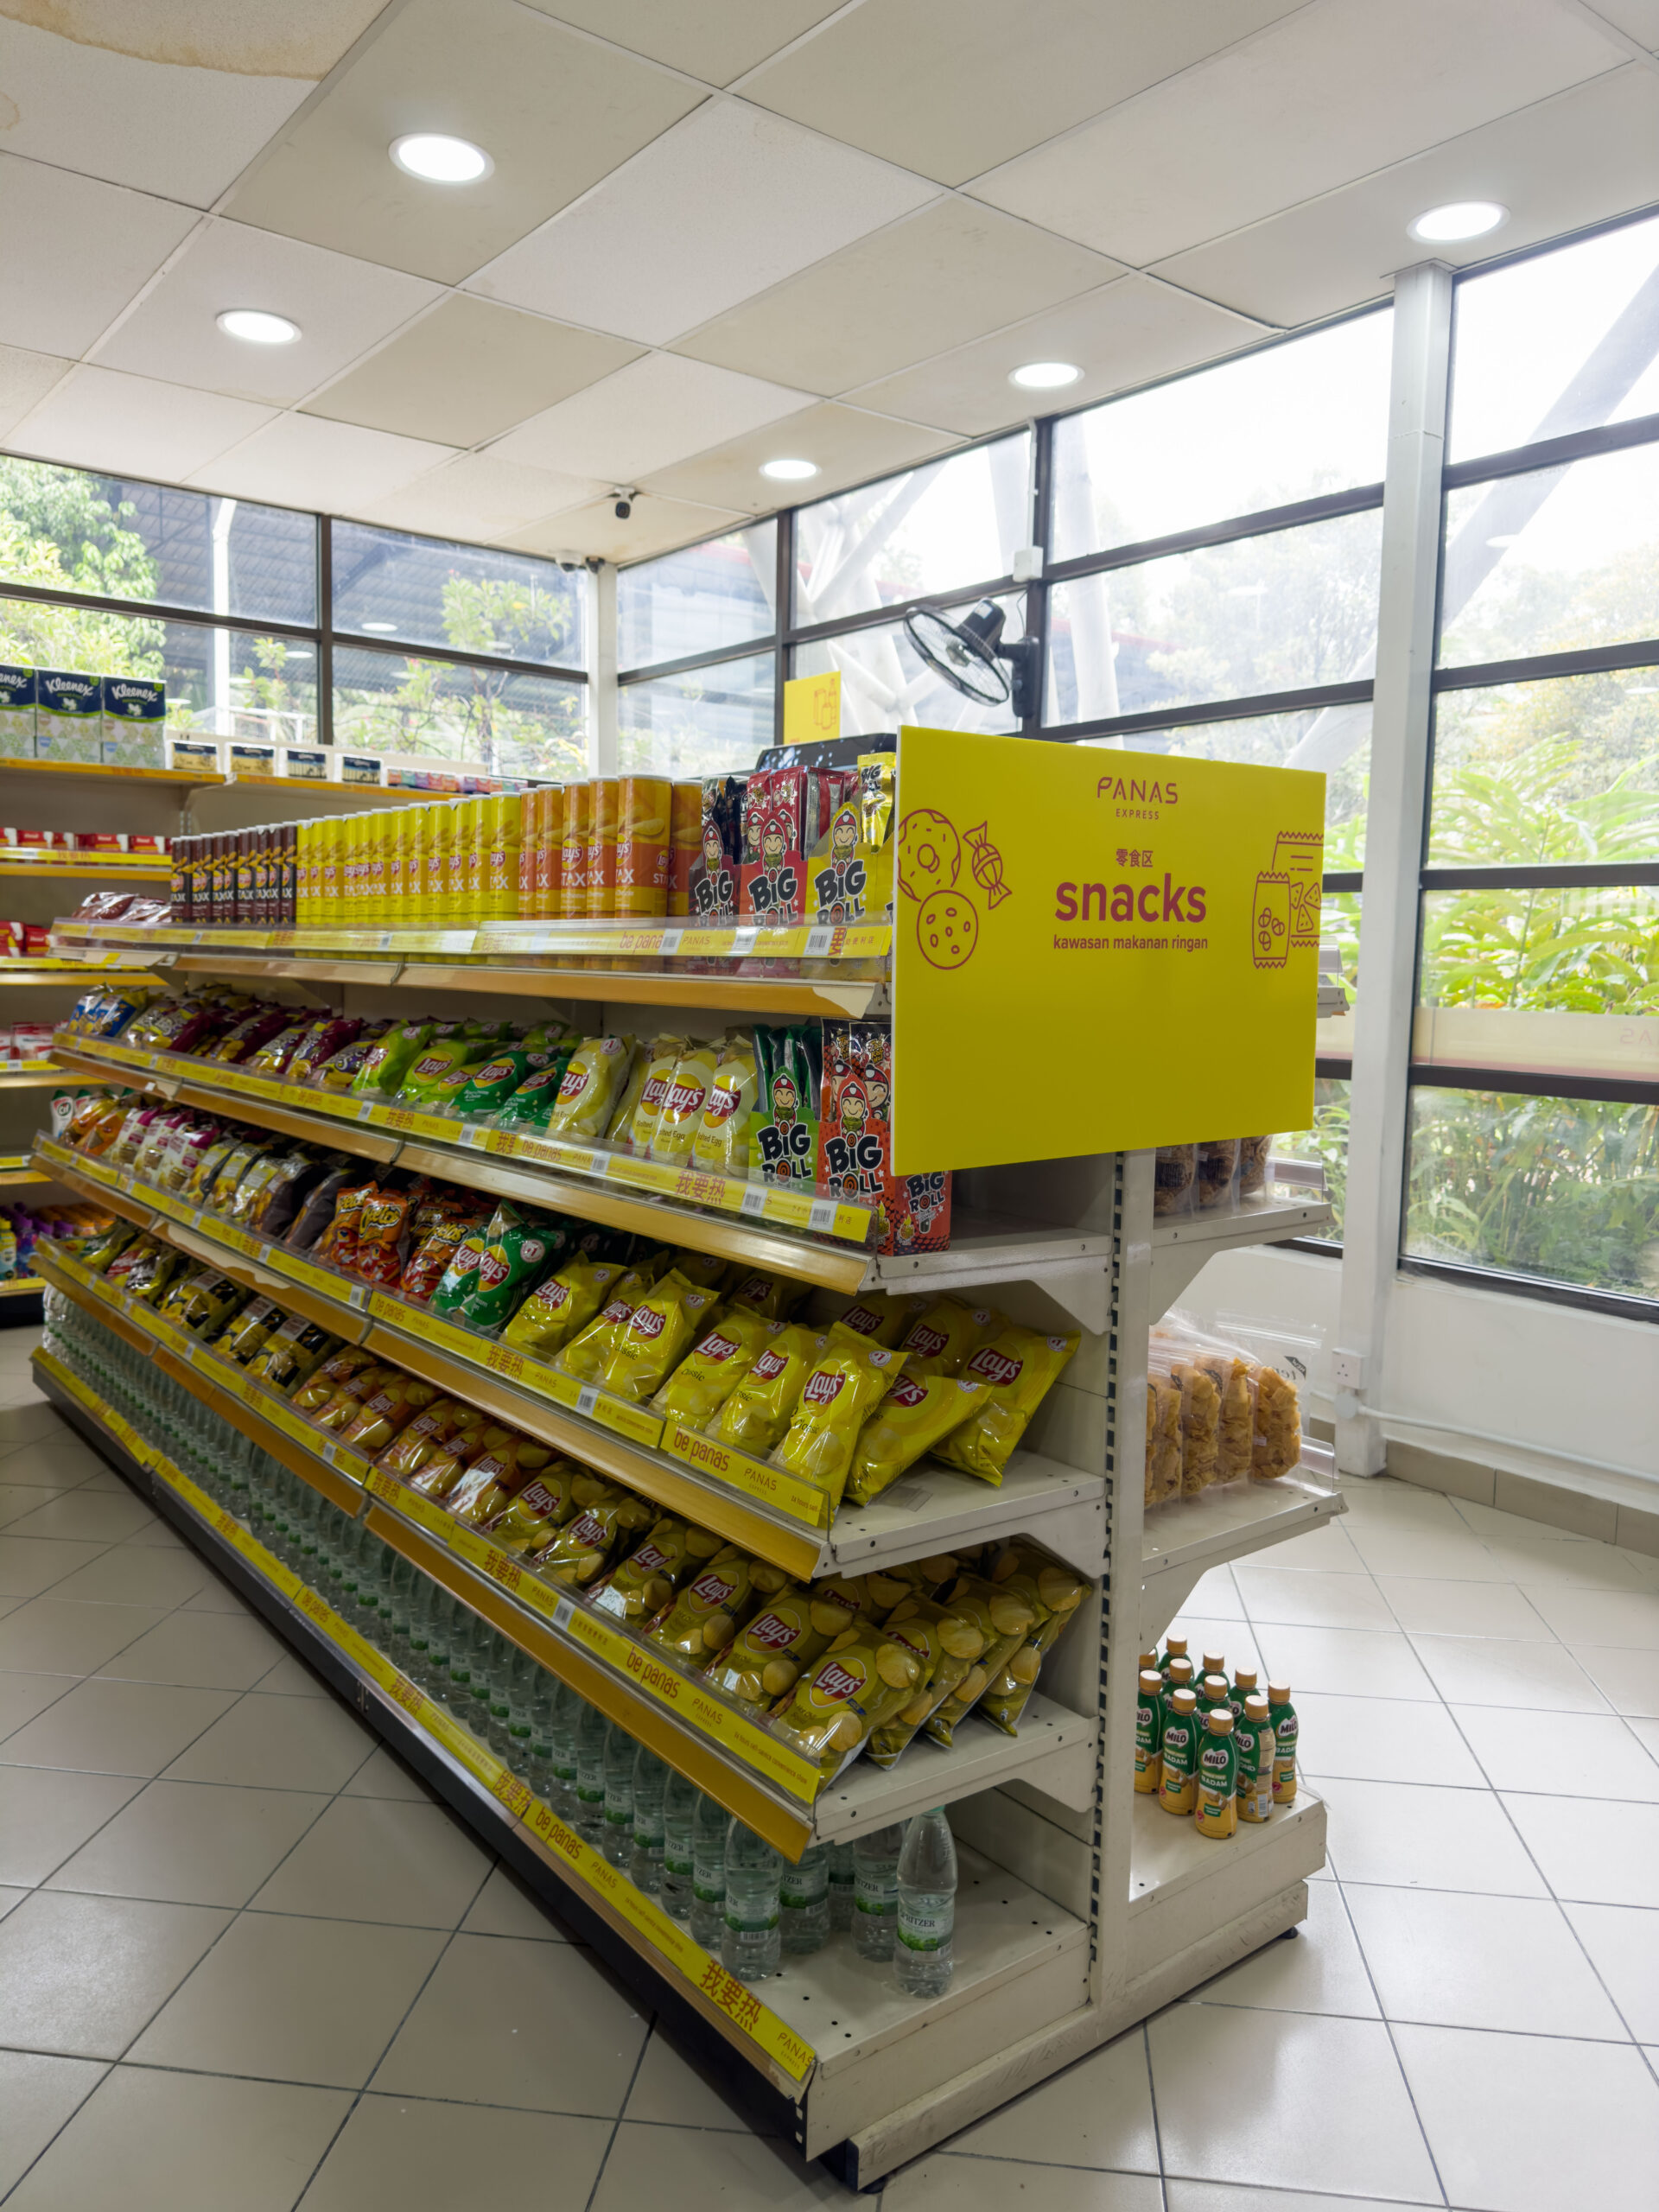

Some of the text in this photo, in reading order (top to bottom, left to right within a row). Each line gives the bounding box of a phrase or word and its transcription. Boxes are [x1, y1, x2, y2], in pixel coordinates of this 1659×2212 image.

[46, 677, 94, 696] Kleenex
[111, 683, 158, 702] Kleenex
[1096, 776, 1179, 804] PANAS
[1116, 808, 1160, 820] EXPRESS
[1116, 849, 1154, 868] 零食区
[1055, 873, 1207, 923] snacks
[634, 935, 664, 954] pana
[1053, 934, 1208, 953] kawasan makanan ringan
[762, 1159, 813, 1185] ROLL
[828, 1172, 884, 1199] ROLL
[676, 1171, 726, 1205] 我要热
[908, 1191, 945, 1214] ROLL
[536, 1279, 570, 1308] Lay's
[696, 1332, 740, 1360] Lay's
[907, 1324, 950, 1357] Lay's
[486, 1344, 524, 1381] 我要热
[752, 1350, 789, 1380] Lay's
[969, 1348, 1024, 1387] Lay's
[804, 1370, 845, 1405] Lay's
[674, 1426, 778, 1491] be panas PANAS
[522, 1480, 558, 1511] Lay's
[483, 1548, 523, 1593] 我要热
[694, 1575, 734, 1604] Lay's
[753, 1613, 796, 1643] Lay's
[626, 1646, 723, 1725] be panas PANAS
[816, 1662, 861, 1696] Lay's
[1166, 1732, 1187, 1744] MILO
[1204, 1753, 1227, 1764] MILO
[1201, 1775, 1228, 1787] BADAM
[535, 1806, 620, 1889] be panas PANAS
[699, 1959, 762, 2032] 我要热
[778, 2031, 814, 2068] PANAS
